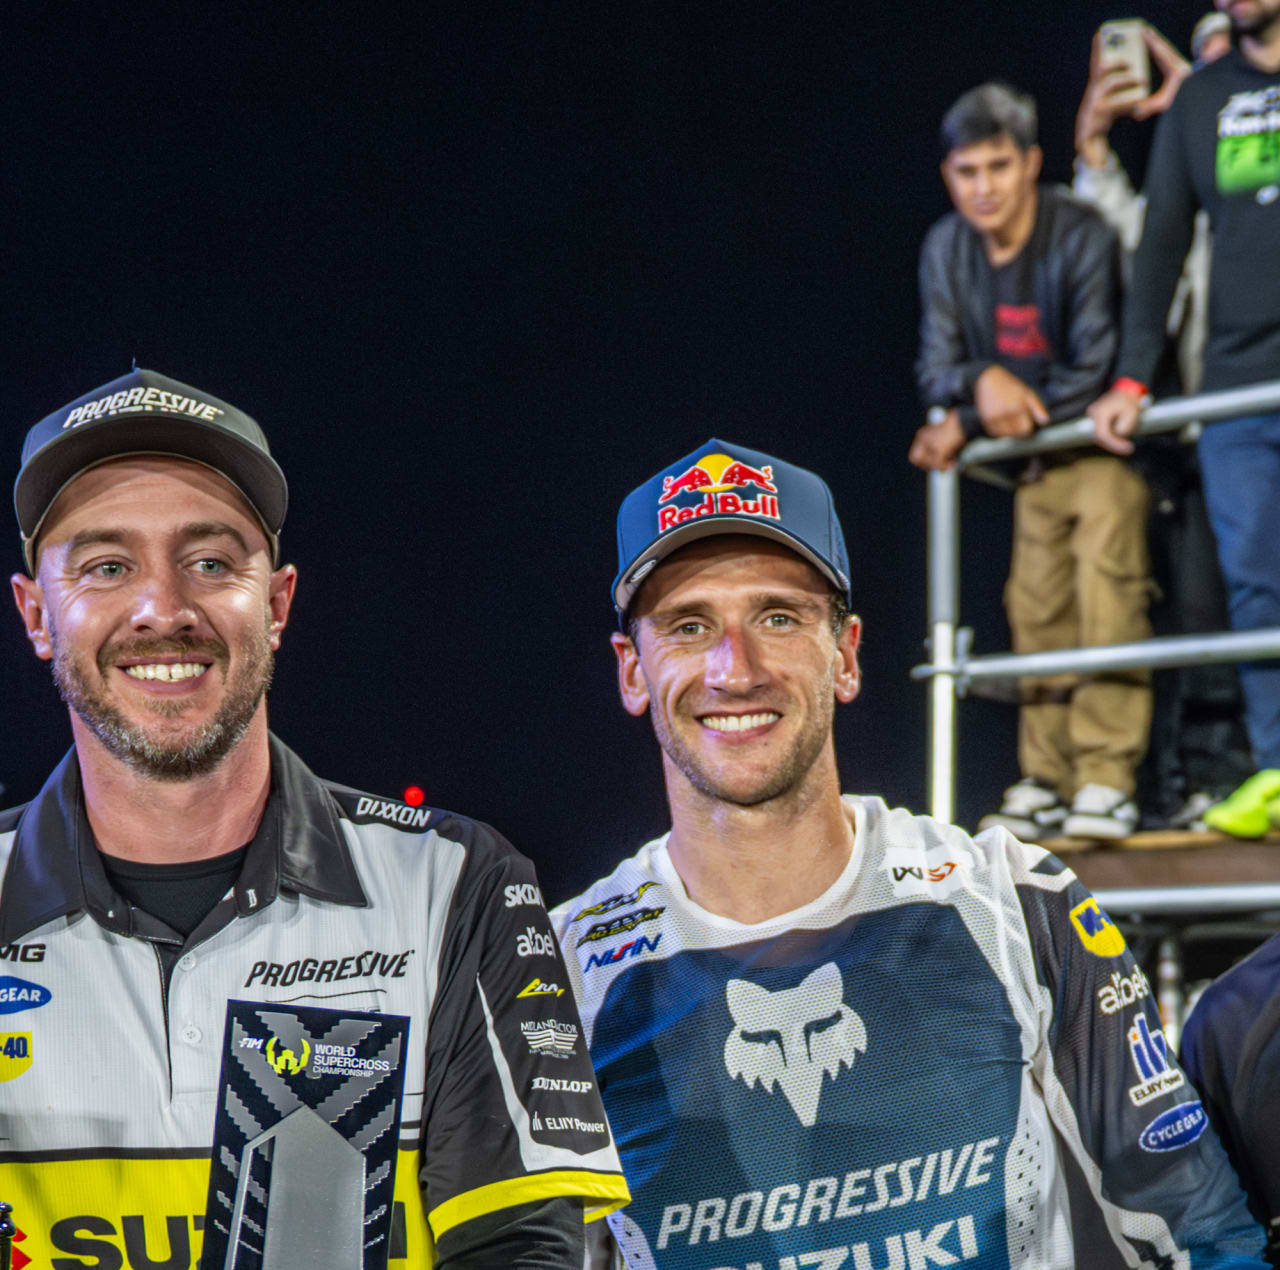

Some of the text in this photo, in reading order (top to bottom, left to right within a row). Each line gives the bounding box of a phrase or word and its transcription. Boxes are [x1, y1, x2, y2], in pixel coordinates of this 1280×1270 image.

[63, 386, 220, 428] PROGRESSIVE
[356, 796, 432, 828] DIXXON
[314, 1043, 356, 1058] WORLD
[312, 1065, 374, 1078] CHAMPIONSHIP
[313, 1054, 390, 1071] SUPERCROSS
[531, 1076, 593, 1094] DUNLOP
[656, 1136, 1000, 1251] PROGRESSIVE
